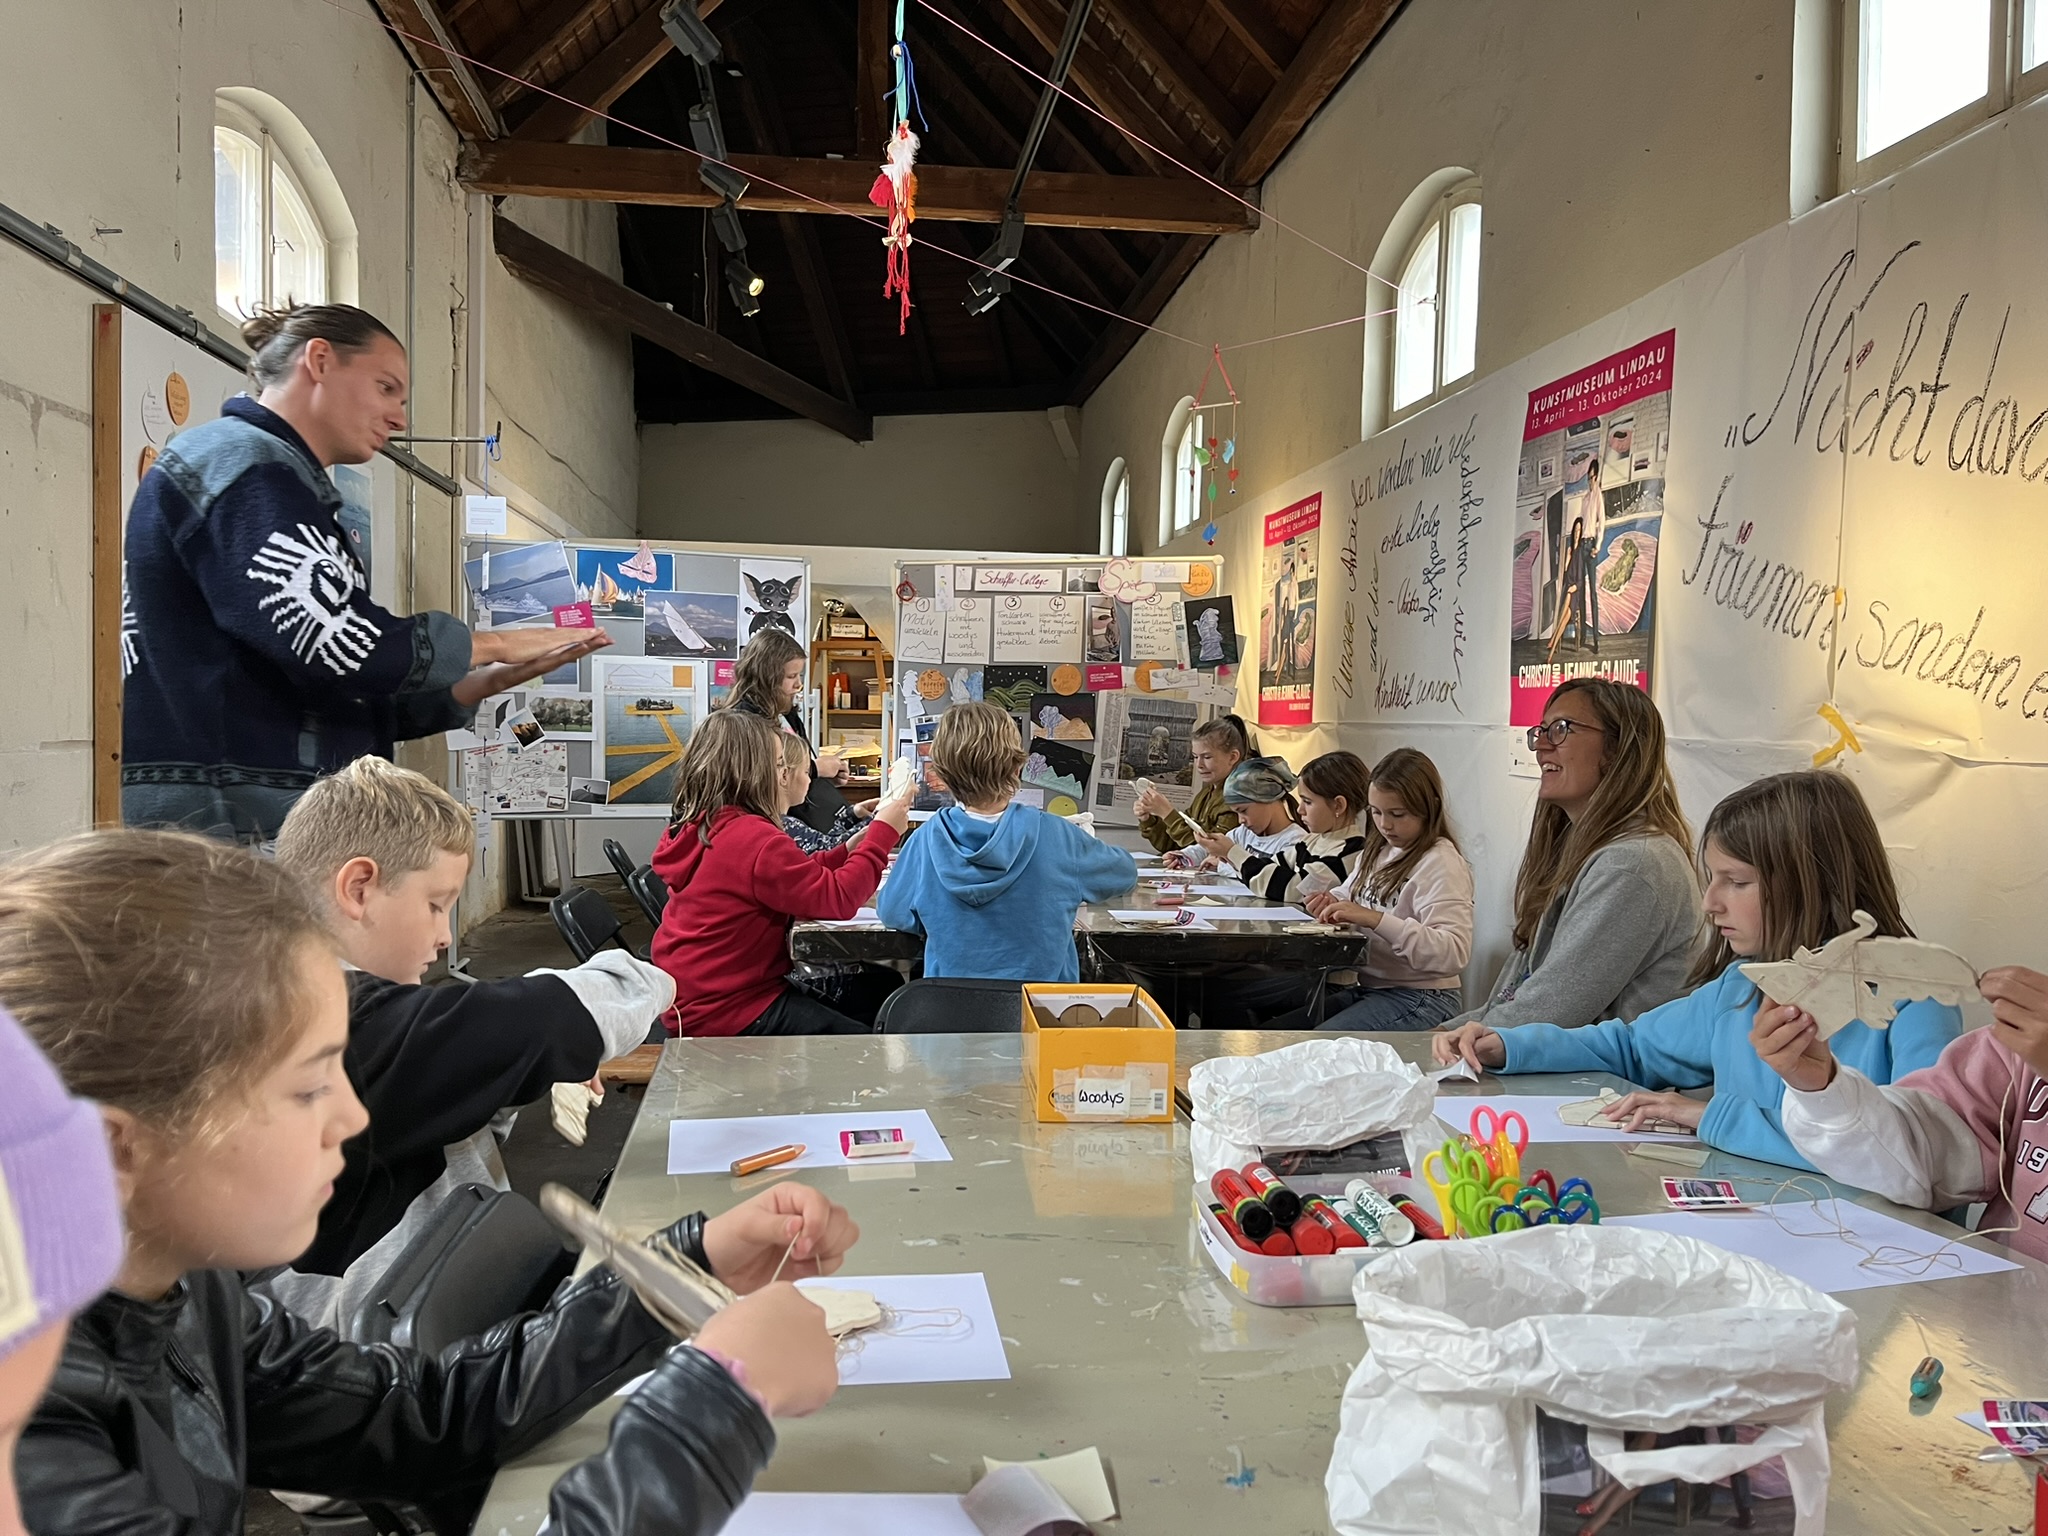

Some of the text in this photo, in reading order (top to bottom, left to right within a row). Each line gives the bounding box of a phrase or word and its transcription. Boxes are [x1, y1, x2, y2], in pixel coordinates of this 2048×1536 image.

[1532, 346, 1667, 415] KUNSTMUSEUM LINDAU
[1531, 419, 1541, 430] 13.
[1543, 407, 1566, 426] April
[1578, 398, 1590, 412] 13.
[1593, 382, 1633, 406] Oktober
[1635, 368, 1663, 389] 2024
[903, 612, 935, 626] Motiv
[1519, 663, 1552, 688] CHRISTO
[1551, 663, 1561, 687] UND
[1078, 1089, 1124, 1108] Woodys
